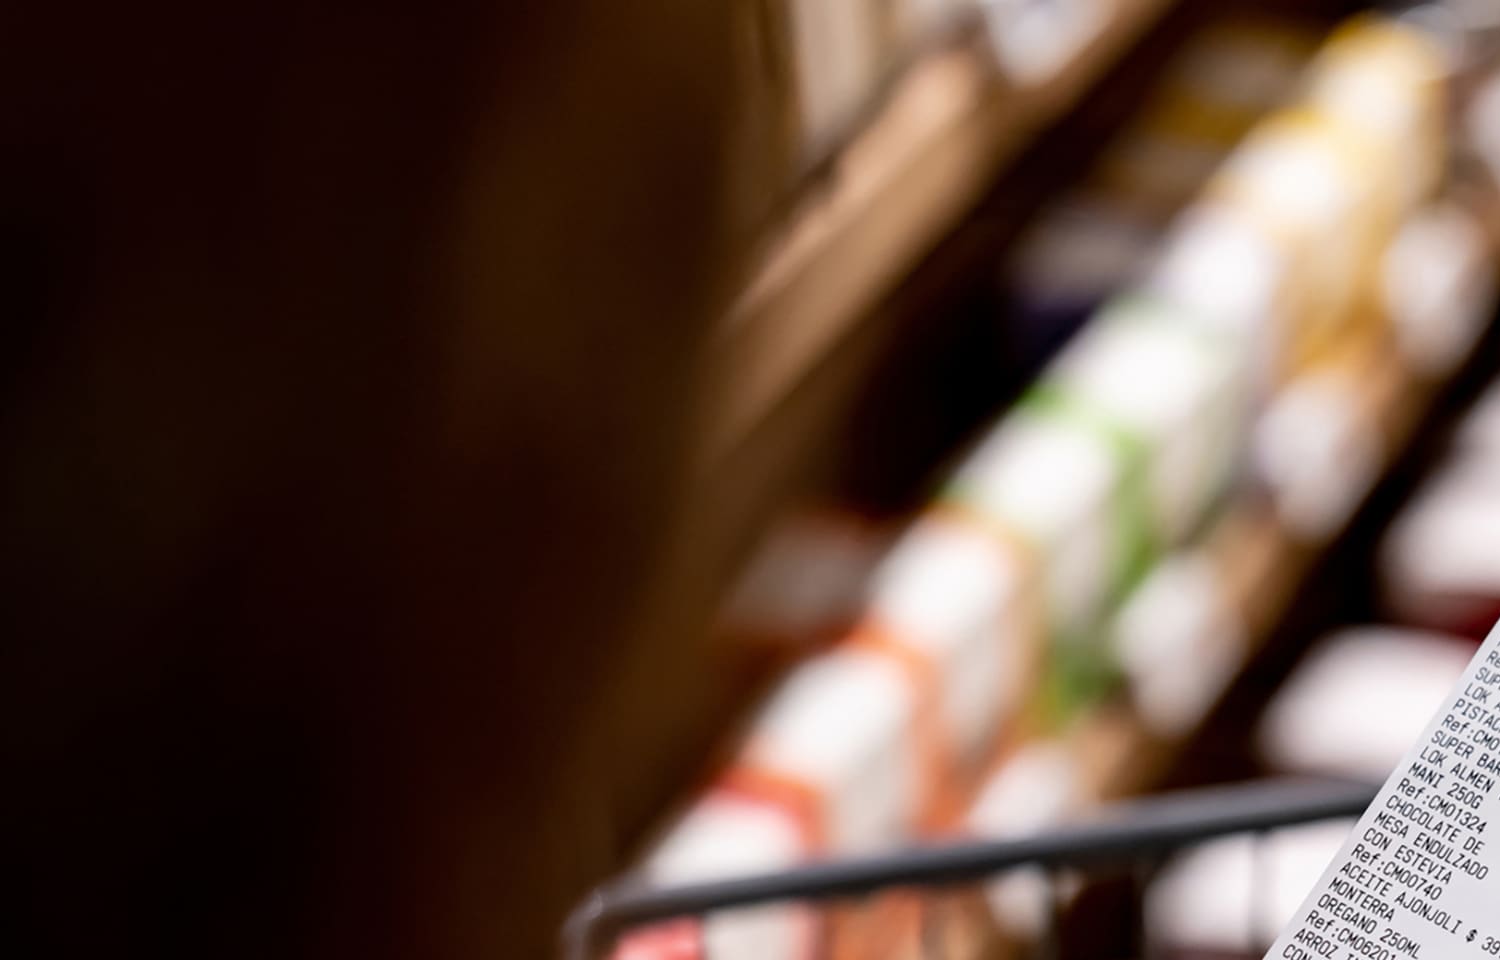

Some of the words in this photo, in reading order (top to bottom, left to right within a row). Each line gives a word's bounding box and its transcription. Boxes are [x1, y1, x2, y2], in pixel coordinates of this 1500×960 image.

[1463, 682, 1492, 704] LOK
[1419, 745, 1448, 768] LOK
[1449, 762, 1495, 793] ALMEN
[1430, 729, 1475, 760] SUPER
[1396, 777, 1487, 834] Ref:CM01324
[1407, 761, 1444, 788] MANI
[1445, 781, 1483, 809] 250G
[1373, 810, 1409, 839] MESA
[1412, 831, 1488, 880] ENDULZADO
[1385, 794, 1462, 843] CHOCOLATE
[1462, 835, 1484, 855] DE
[1350, 842, 1442, 900] Ref:CM00740
[1362, 827, 1392, 851] CON
[1393, 844, 1452, 884] ESTEVIA
[1327, 876, 1395, 922] MONTERRA
[1338, 860, 1393, 897] ACEITE
[1393, 890, 1462, 934] AJONJOLI
[1293, 927, 1339, 960] ARROZ
[1316, 893, 1377, 934] OREGANO
[1378, 927, 1420, 959] 250ML
